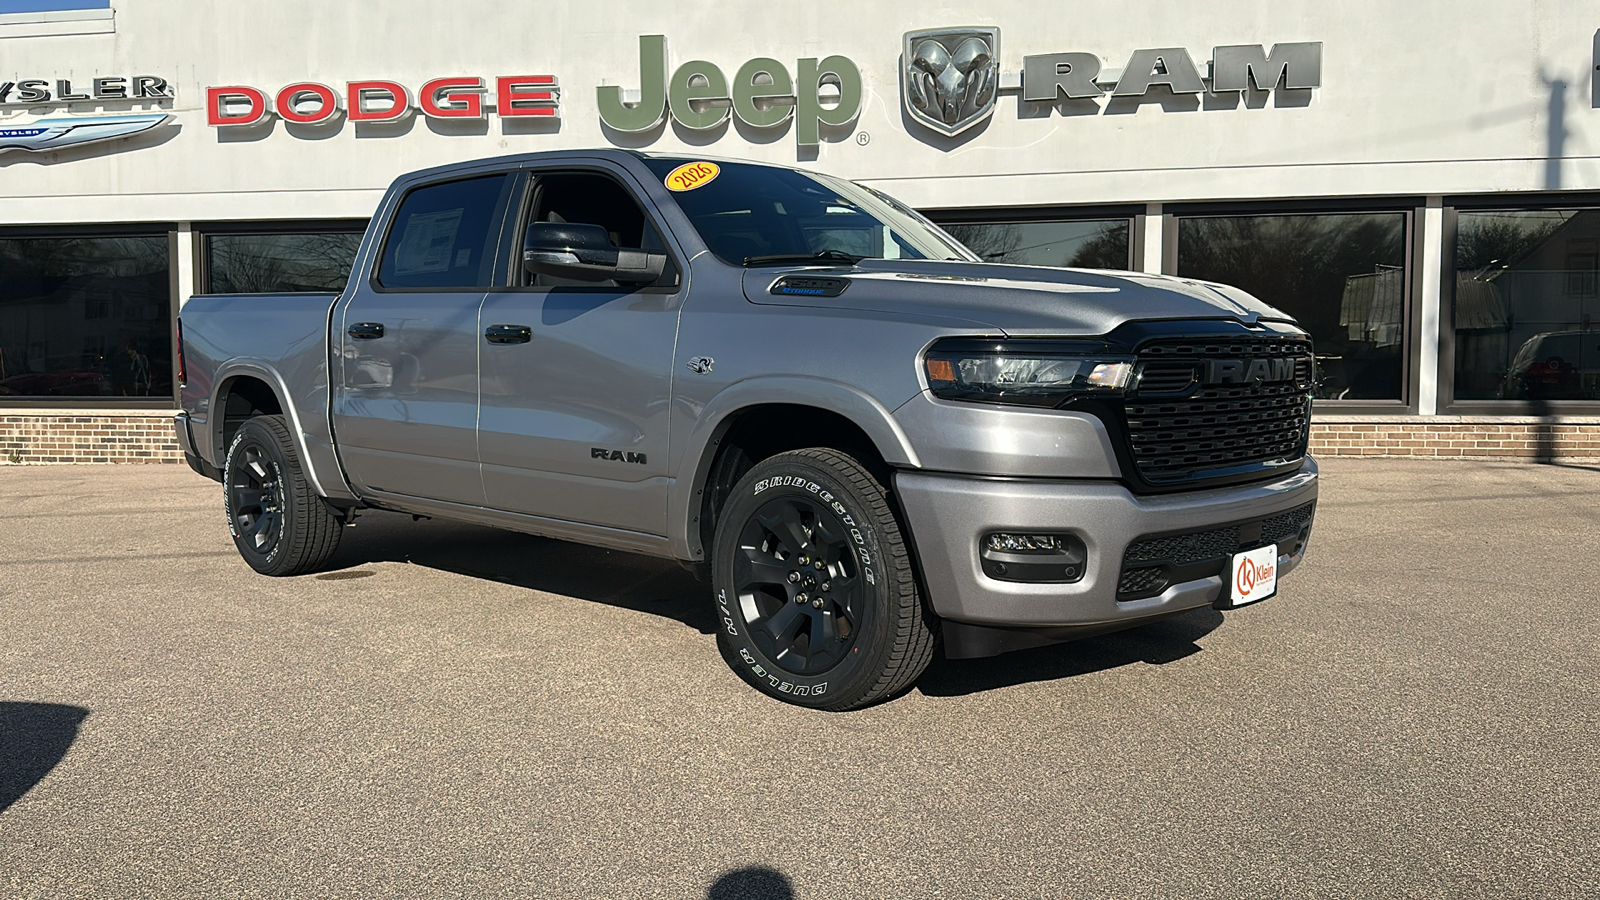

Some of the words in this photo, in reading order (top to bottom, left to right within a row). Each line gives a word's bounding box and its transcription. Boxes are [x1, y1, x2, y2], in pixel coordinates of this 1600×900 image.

[596, 34, 863, 146] Jeep
[1021, 41, 1323, 101] RAM
[206, 75, 561, 127] DODGE
[674, 163, 712, 188] 2026
[1210, 358, 1295, 383] RAM
[591, 447, 647, 465] RAM
[753, 475, 876, 586] BRIDGESTONE
[1256, 562, 1274, 582] Klein
[739, 648, 828, 696] DUELER
